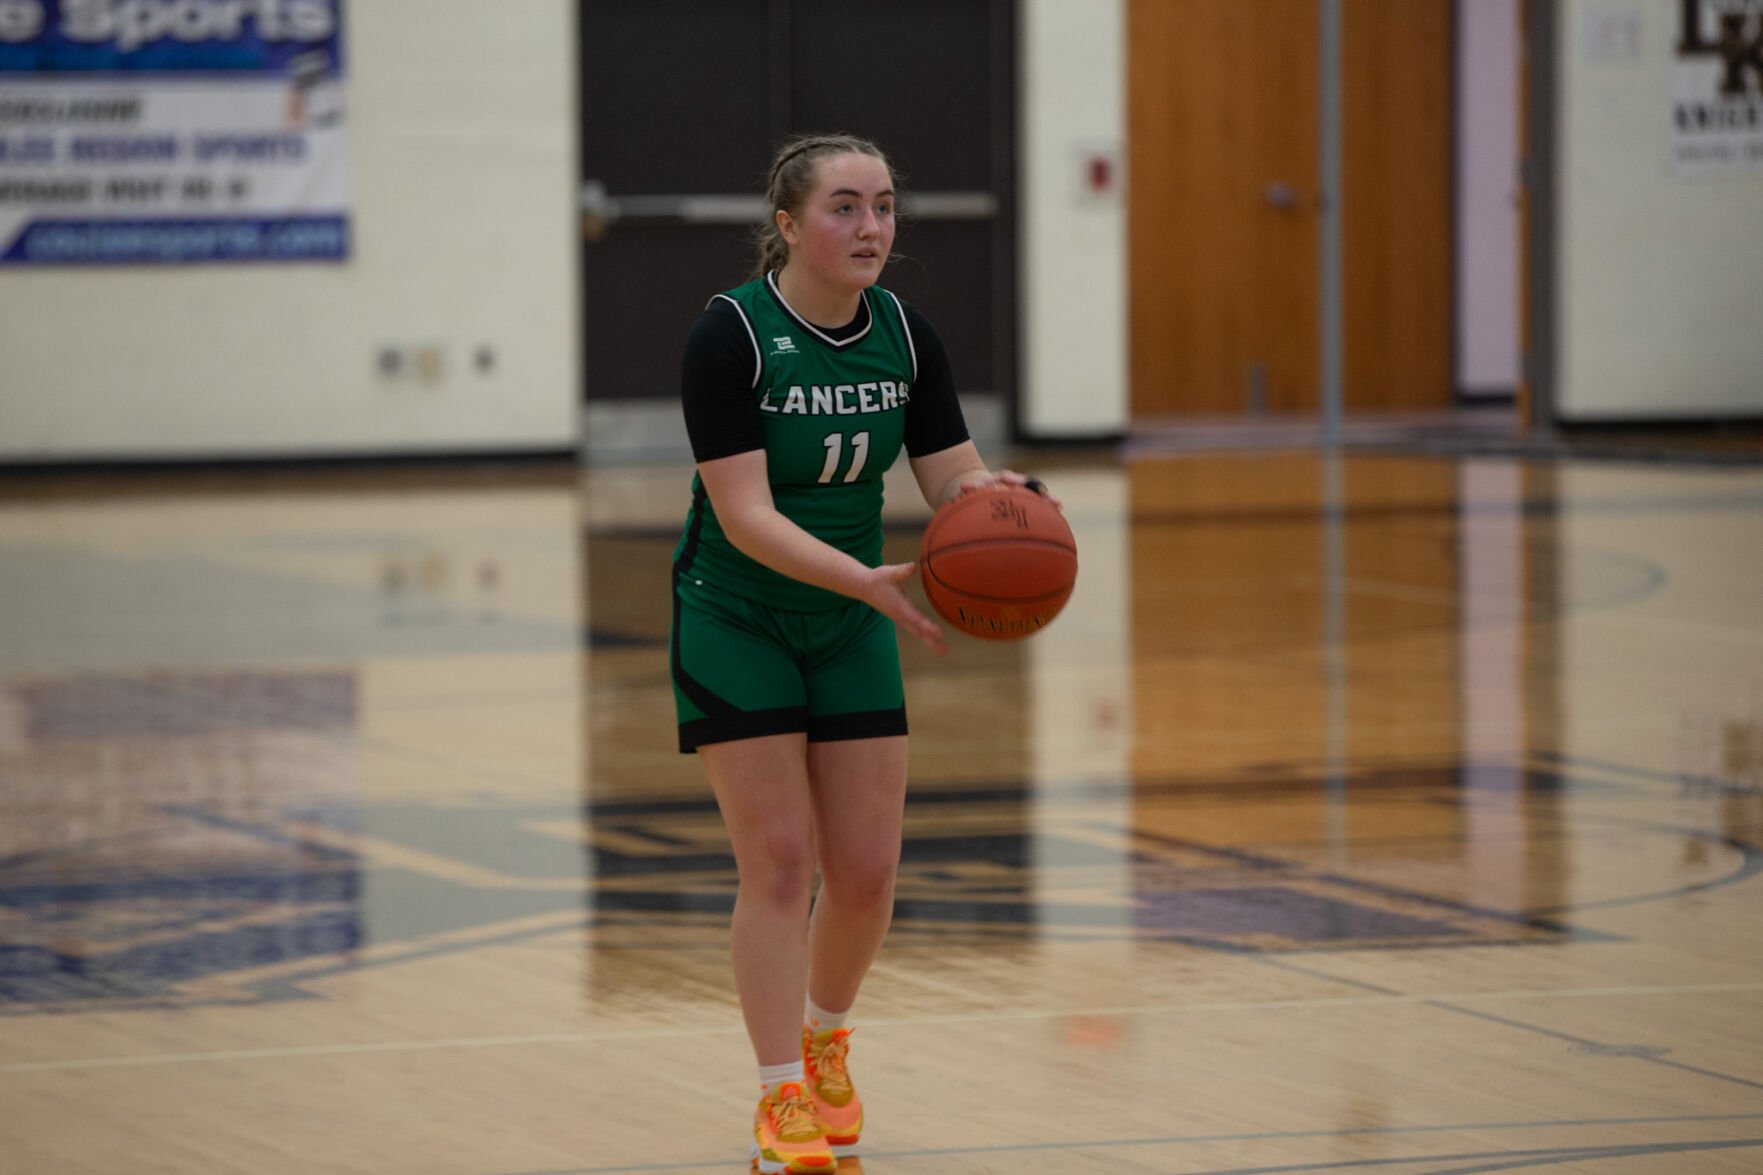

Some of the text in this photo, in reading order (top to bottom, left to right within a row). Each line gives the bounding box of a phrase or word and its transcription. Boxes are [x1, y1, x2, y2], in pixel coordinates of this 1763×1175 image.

[60, 0, 333, 52] Sports
[760, 381, 910, 415] LANCERS
[817, 431, 869, 484] 11
